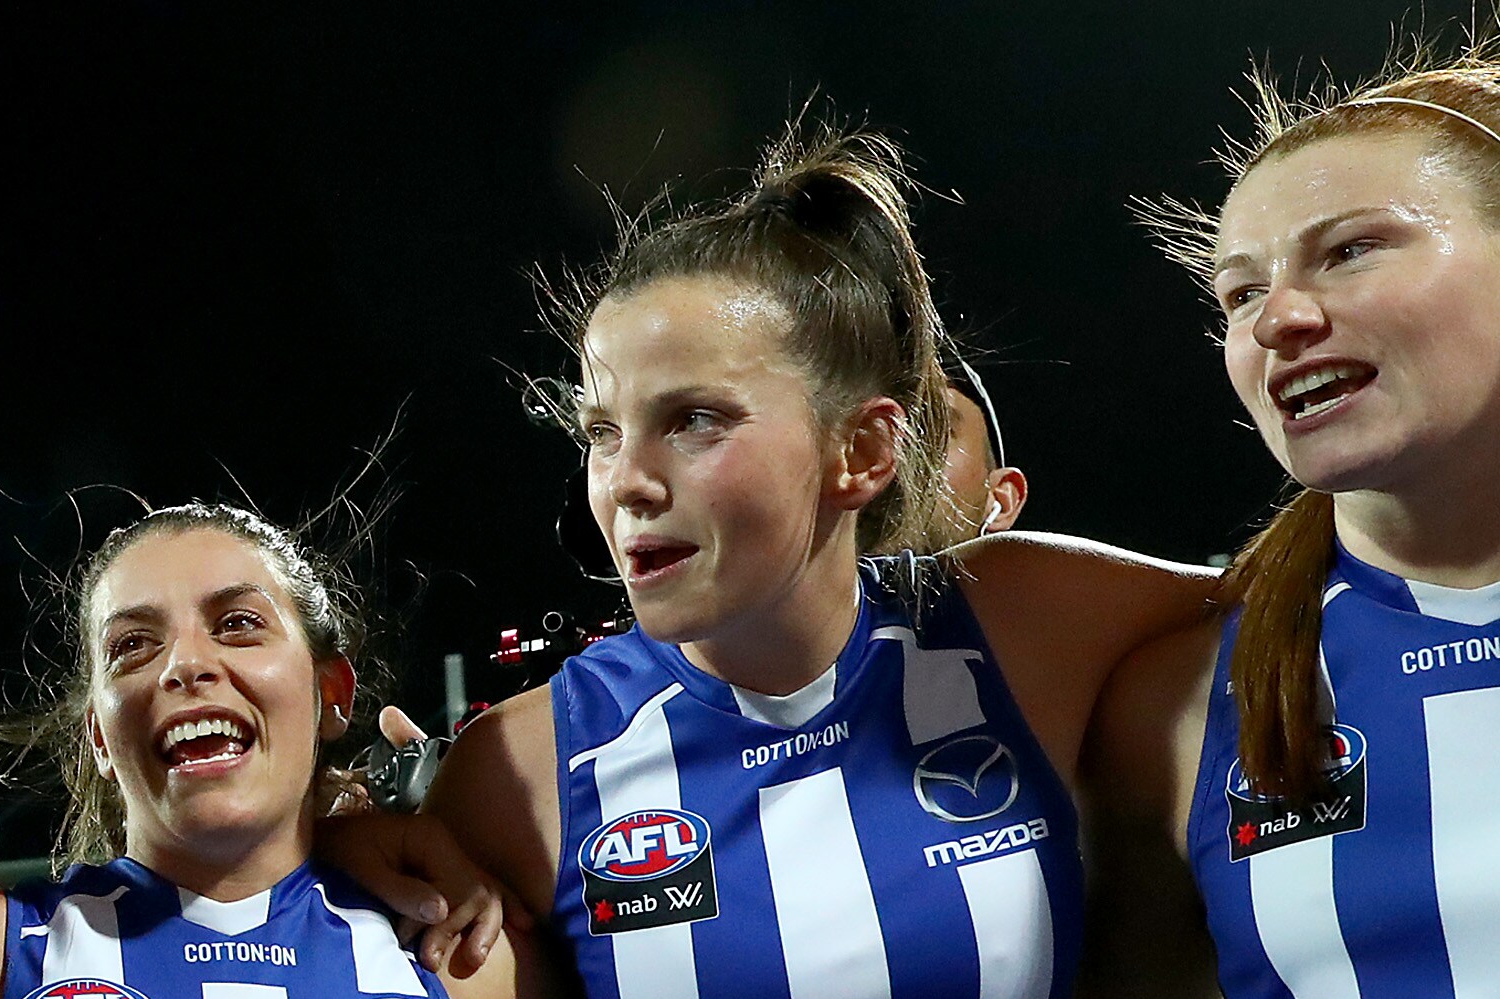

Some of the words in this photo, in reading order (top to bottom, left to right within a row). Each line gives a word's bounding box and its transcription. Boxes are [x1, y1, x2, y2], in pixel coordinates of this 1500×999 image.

[1259, 811, 1301, 836] nab
[594, 822, 698, 869] AFL
[923, 817, 1049, 868] mazda
[617, 893, 658, 915] nab
[185, 942, 297, 966] COTTON:ON
